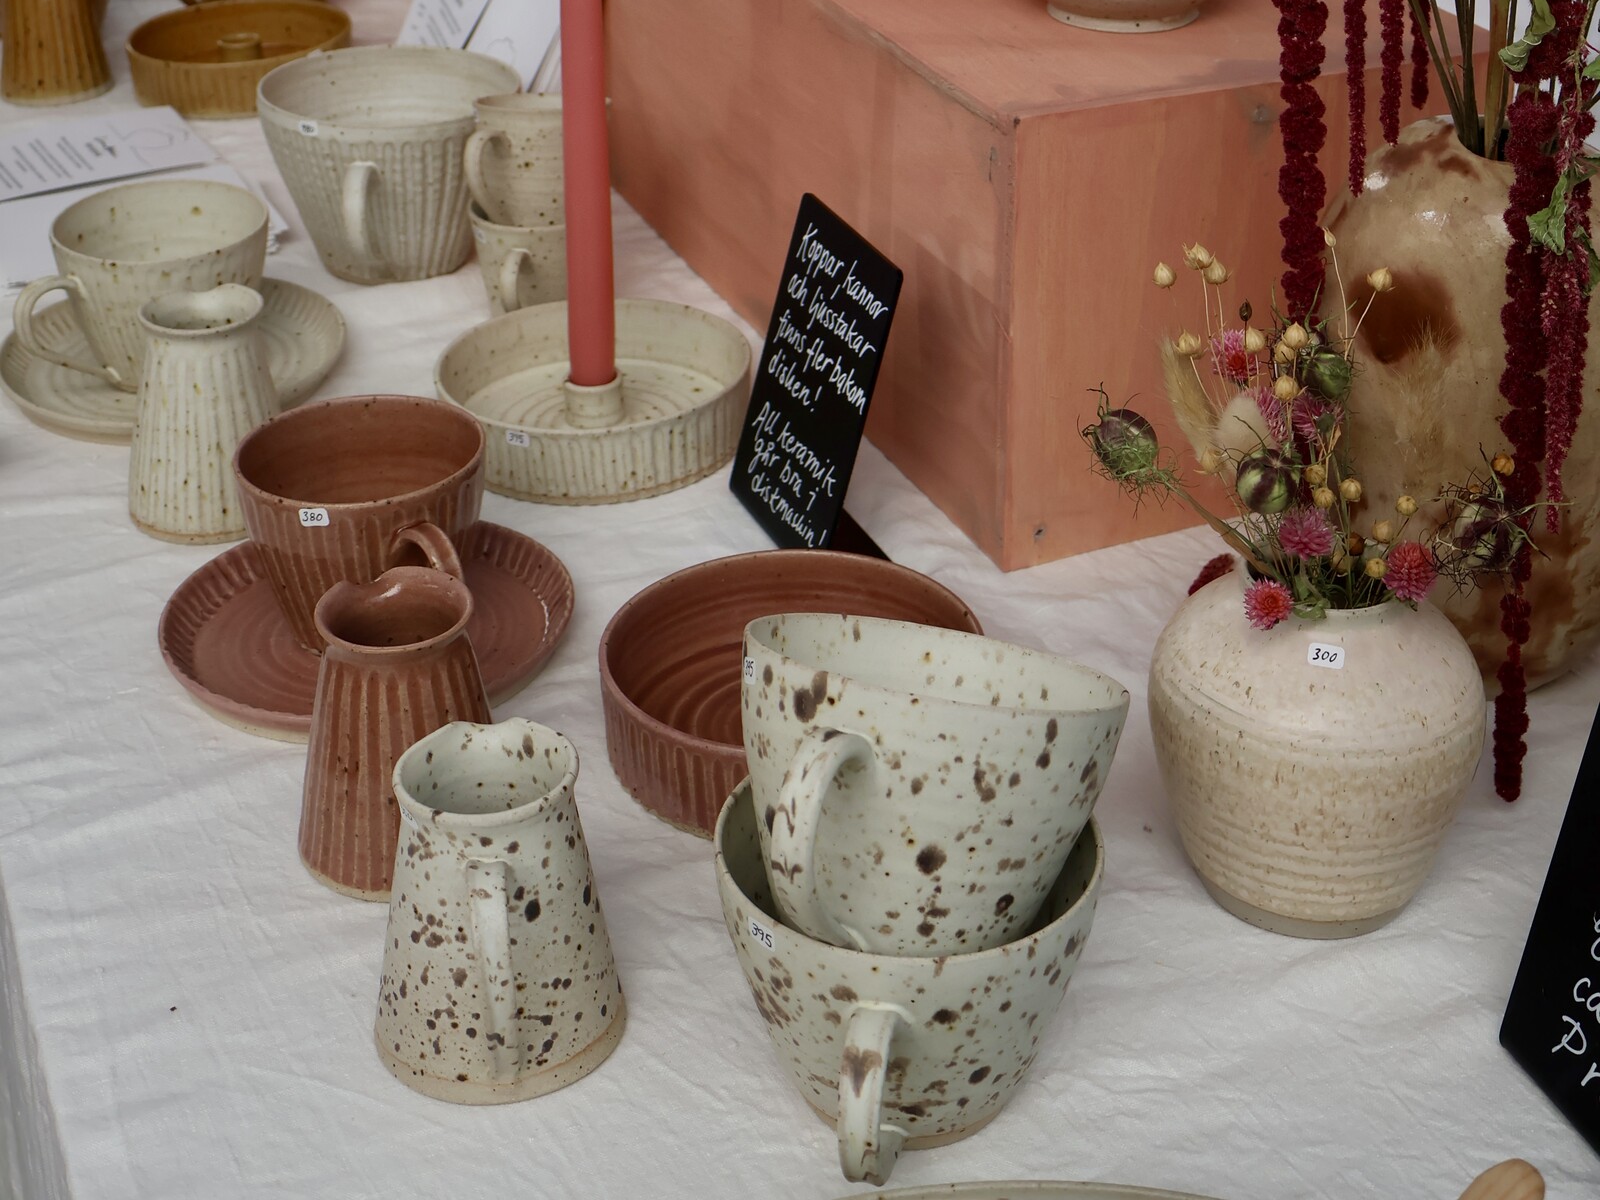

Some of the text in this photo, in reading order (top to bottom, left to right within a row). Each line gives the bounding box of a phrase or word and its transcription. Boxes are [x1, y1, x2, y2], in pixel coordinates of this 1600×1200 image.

[787, 273, 876, 358] och ljusstakar
[841, 259, 889, 320] kannor
[772, 309, 867, 415] finns fler bakom
[747, 438, 820, 511] går bra i
[751, 401, 837, 498] All keramik
[302, 510, 323, 522] 380
[1312, 647, 1338, 663] 300
[751, 922, 773, 948] 395
